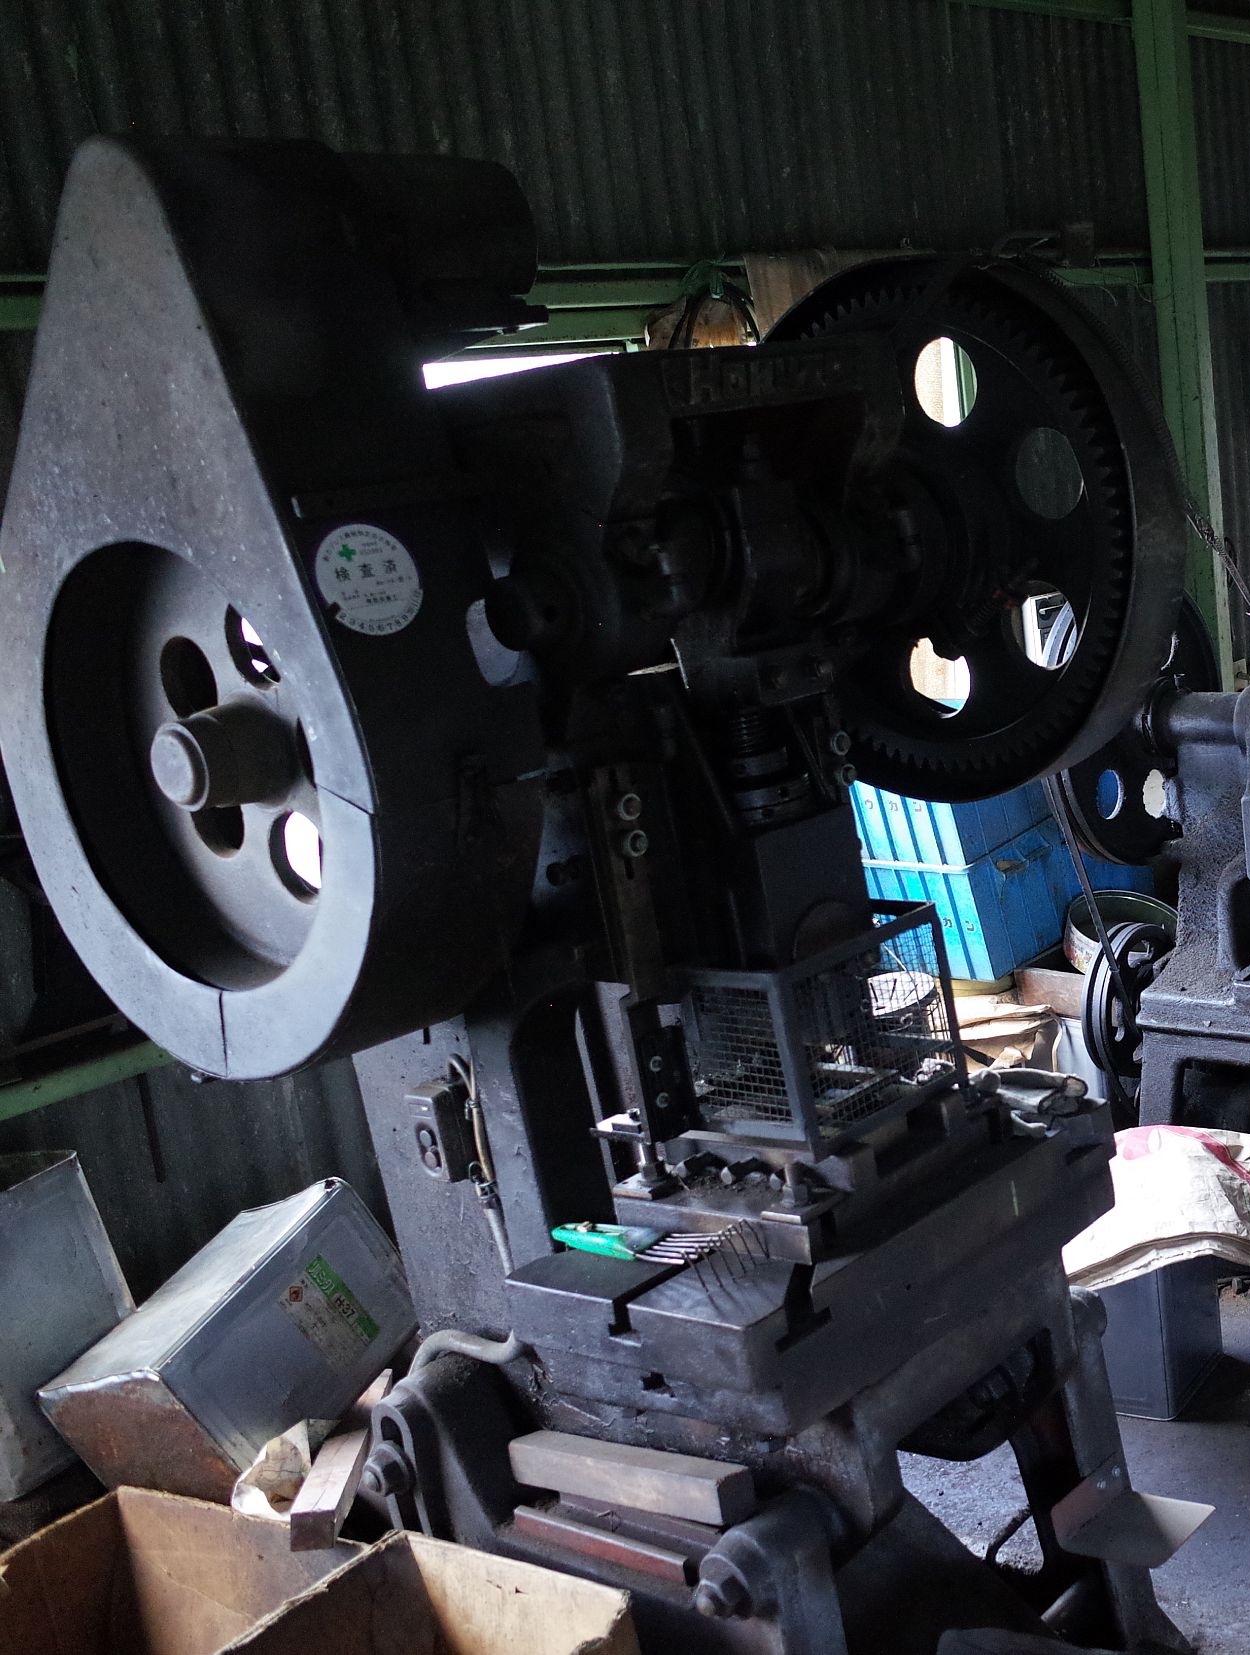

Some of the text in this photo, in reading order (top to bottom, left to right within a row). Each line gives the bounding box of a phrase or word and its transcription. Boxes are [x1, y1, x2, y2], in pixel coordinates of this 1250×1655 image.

[335, 559, 397, 582] 検査済
[335, 1295, 356, 1318] H-37
